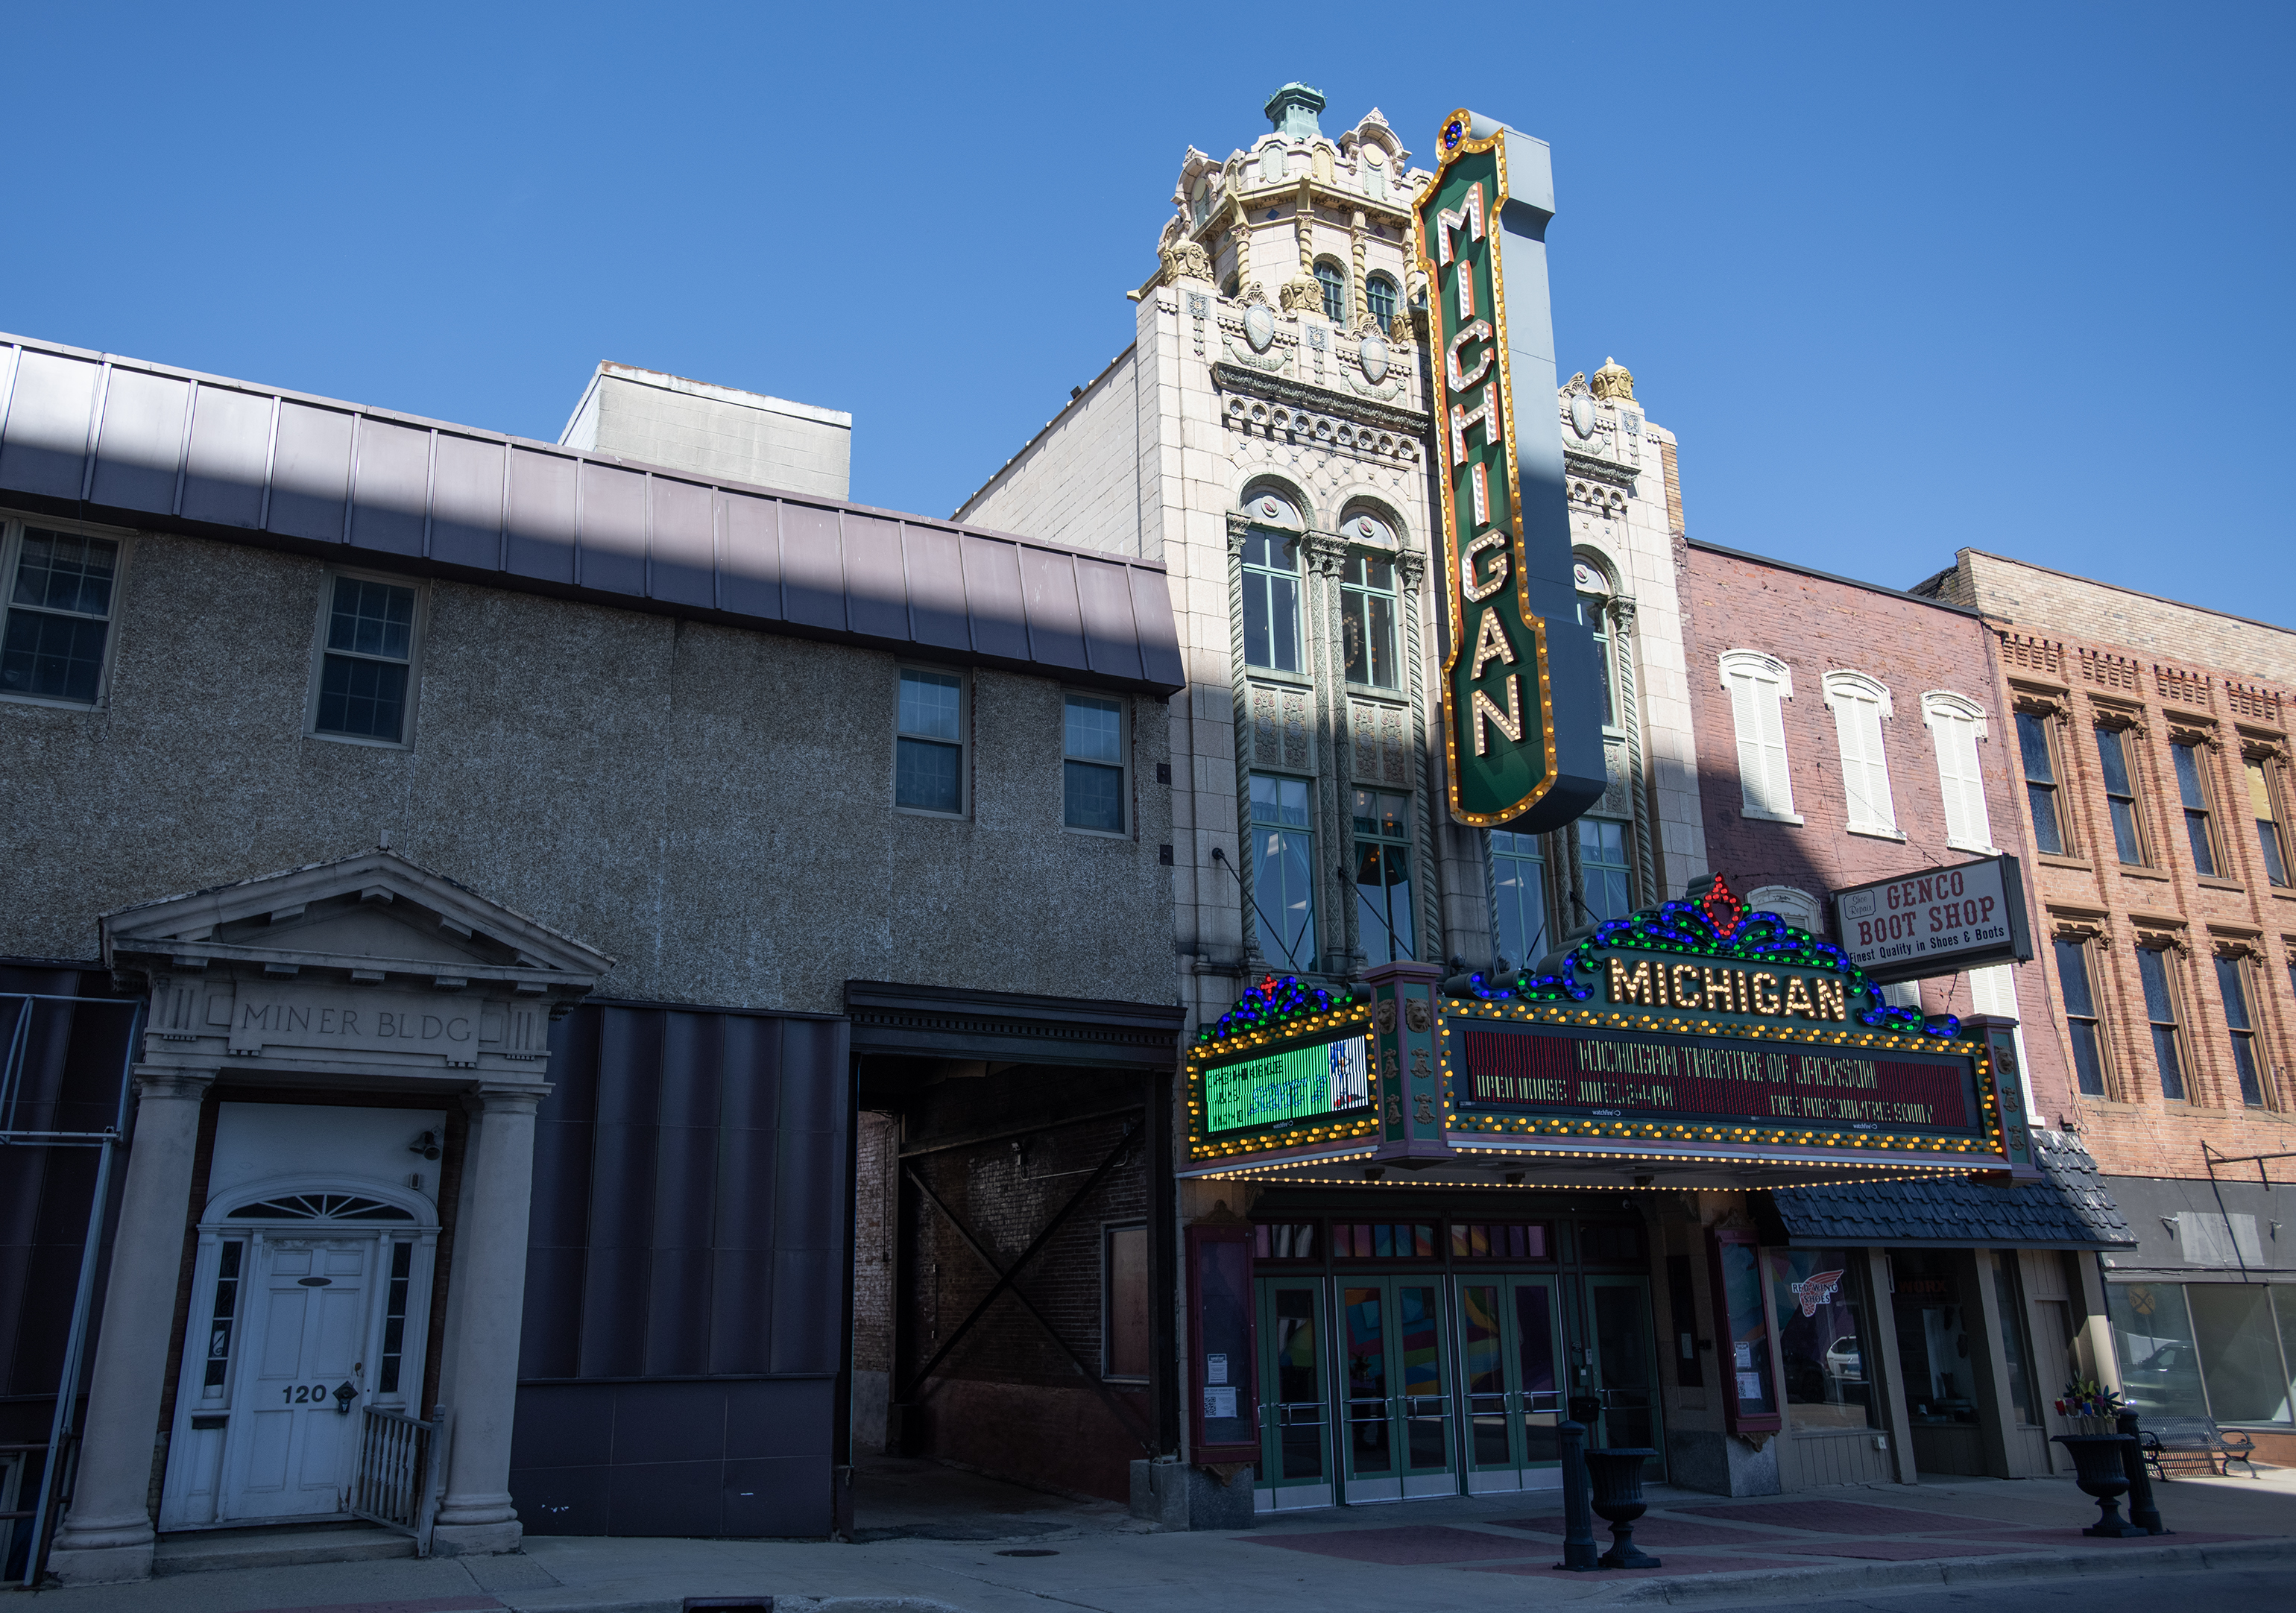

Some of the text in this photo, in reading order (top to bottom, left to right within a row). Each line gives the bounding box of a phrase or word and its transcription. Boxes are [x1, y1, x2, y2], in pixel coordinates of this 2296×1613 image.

[1437, 181, 1525, 757] MICHIGAN
[1852, 894, 1867, 906] Shoe
[1887, 871, 1964, 910] GENCO
[1848, 904, 1873, 916] Repair
[1857, 895, 1996, 946] BOOT SHOP
[1849, 925, 2005, 964] Finest Quality in Shoes & Boots
[1606, 956, 1846, 1021] MICHIGAN
[244, 1003, 362, 1035] MINER
[1578, 1040, 1678, 1076] MICHIGAN
[1796, 1055, 1878, 1089] JACKSON
[1792, 1284, 1838, 1292] RED WING
[1803, 1295, 1830, 1303] SHOES
[1898, 1280, 1947, 1293] WORX
[283, 1384, 327, 1404] 120
